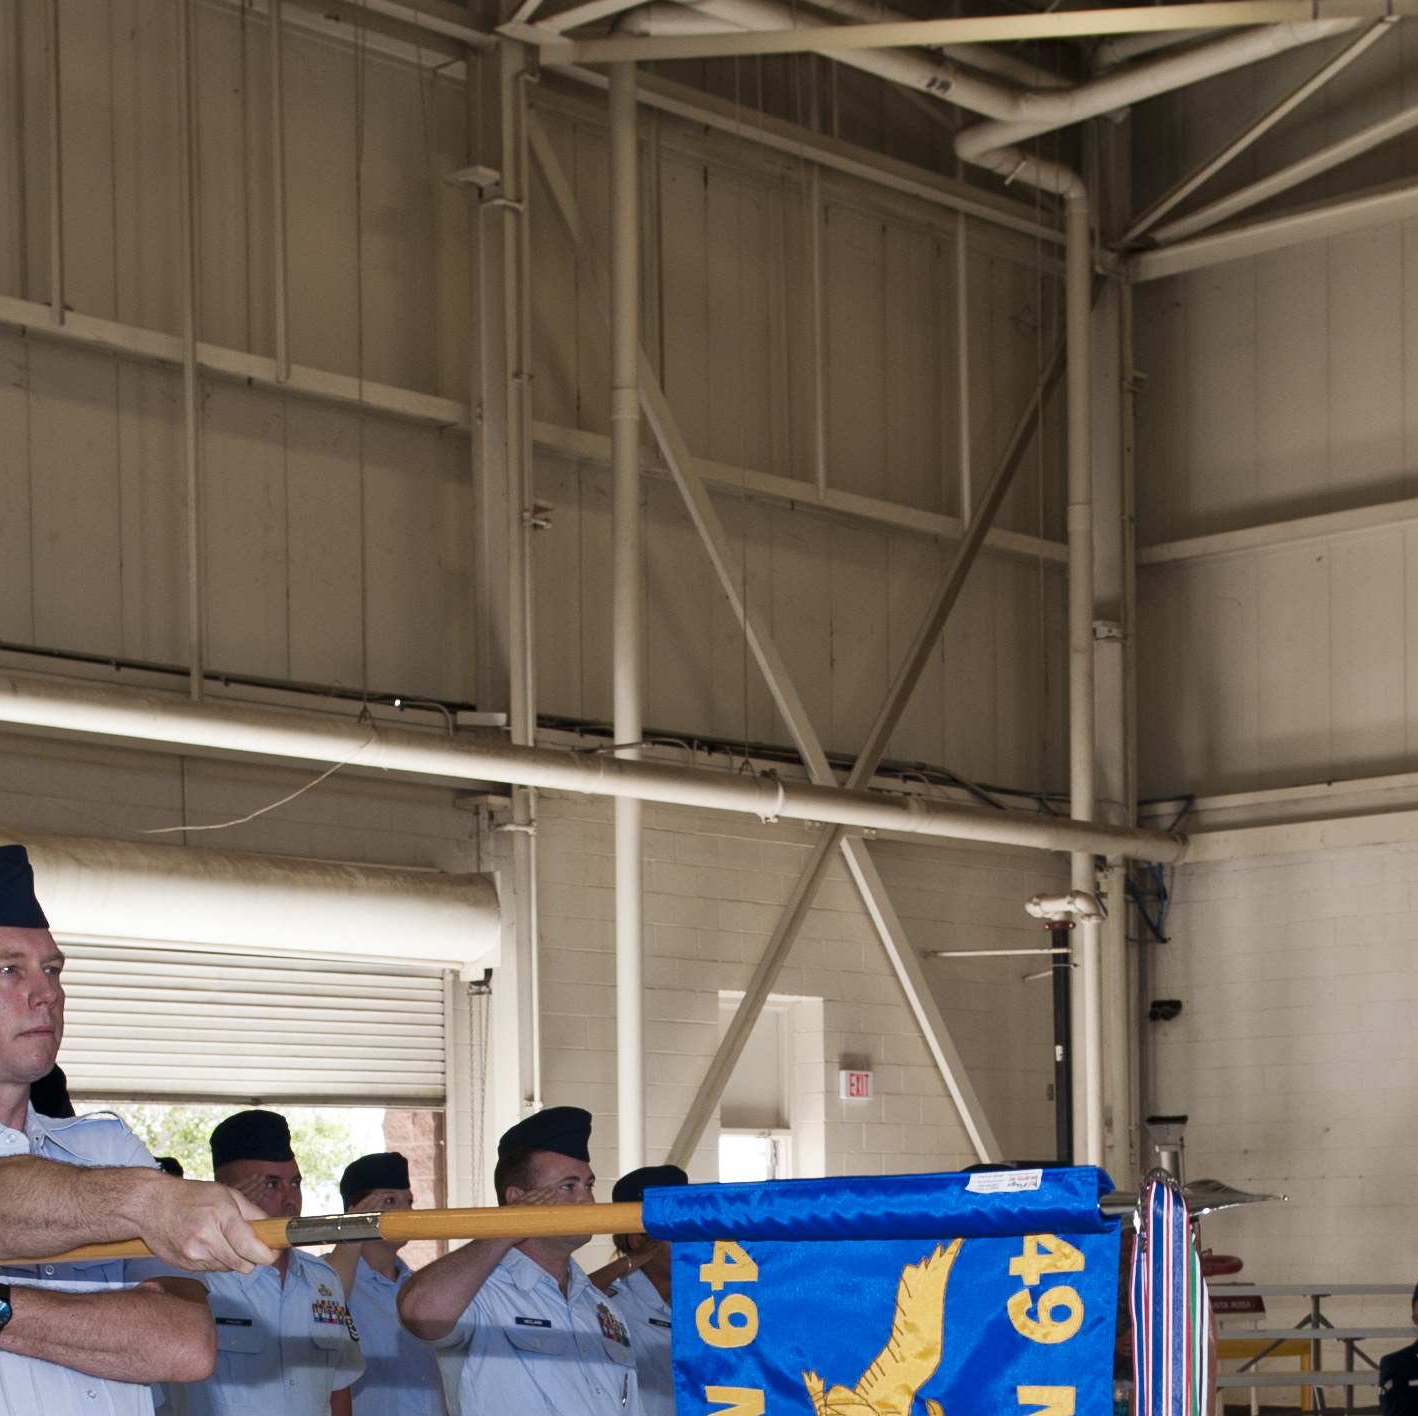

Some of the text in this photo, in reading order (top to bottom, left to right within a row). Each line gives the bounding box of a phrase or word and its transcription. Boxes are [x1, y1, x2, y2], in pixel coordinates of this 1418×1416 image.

[849, 1072, 870, 1097] EXIT
[695, 1239, 760, 1349] 49
[1007, 1232, 1085, 1345] 49
